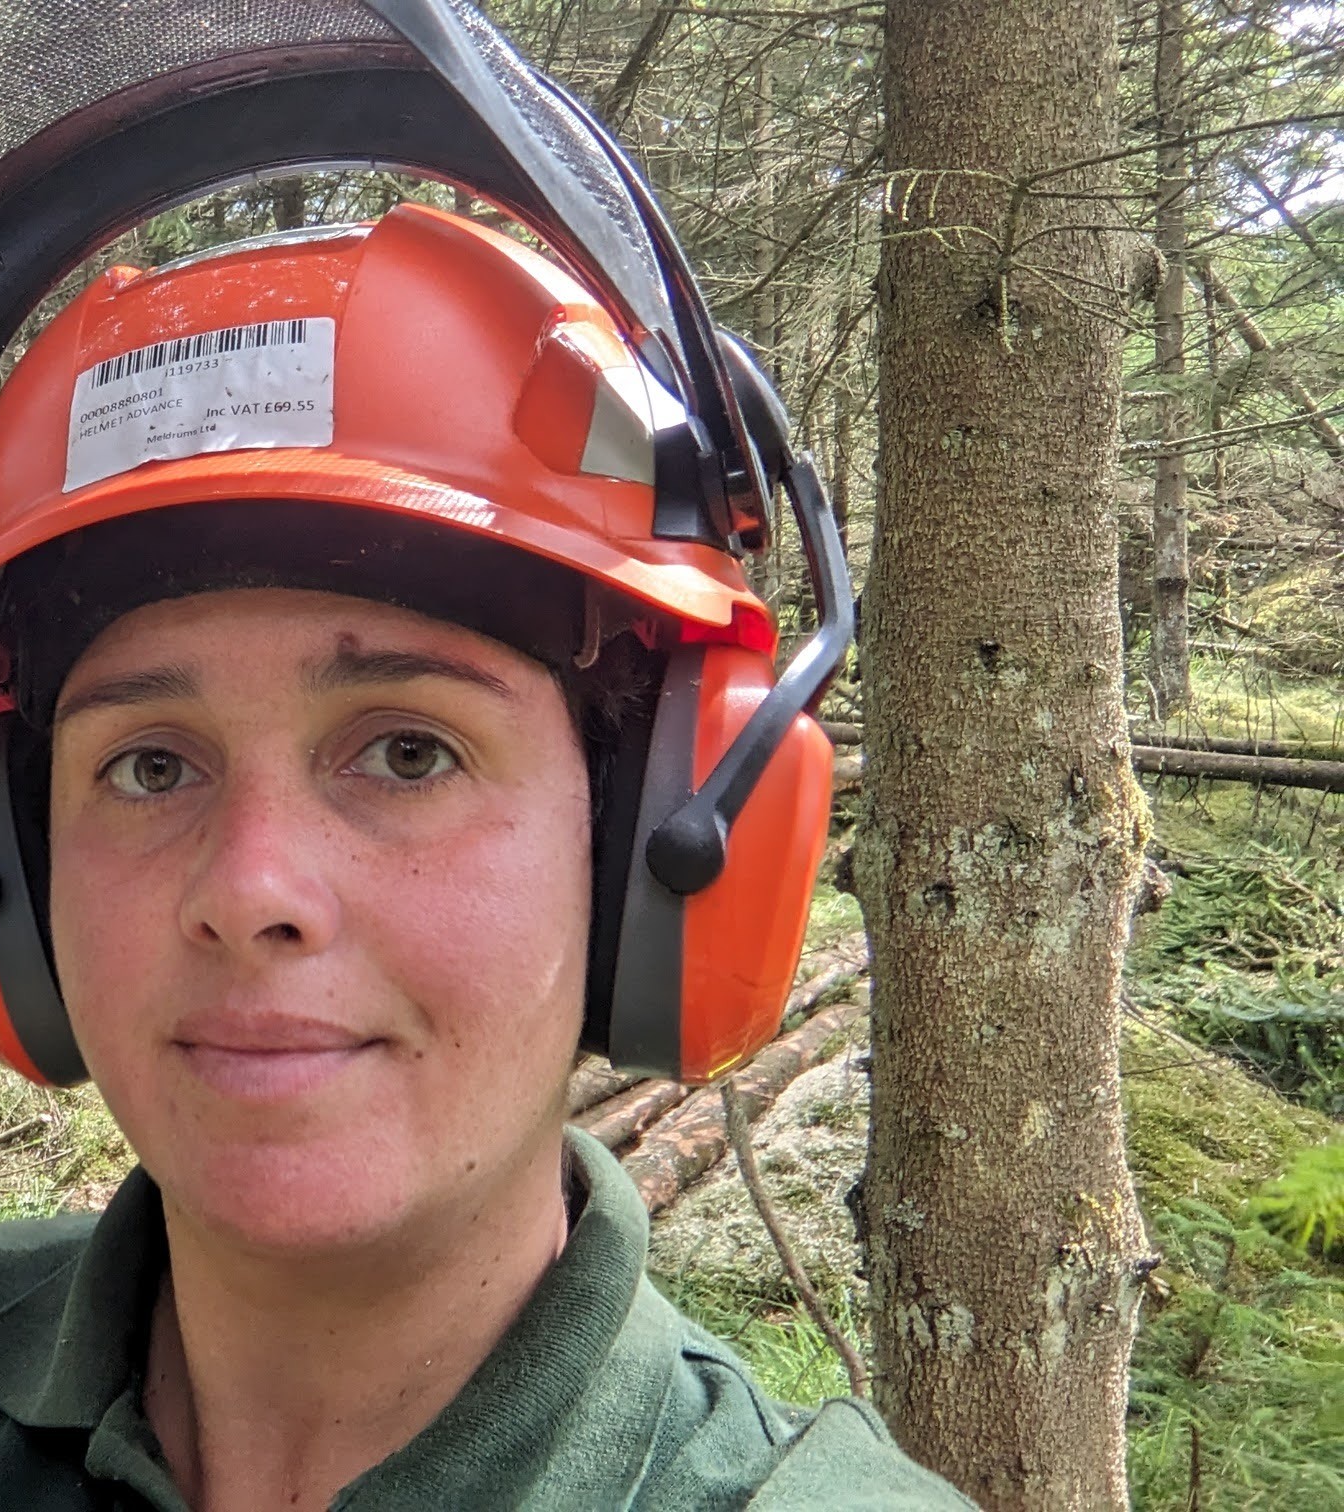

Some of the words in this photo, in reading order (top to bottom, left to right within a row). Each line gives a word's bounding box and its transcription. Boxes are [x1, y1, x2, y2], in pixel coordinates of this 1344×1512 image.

[79, 416, 123, 440] HELMET
[126, 398, 184, 422] ADVANCE
[206, 407, 226, 418] Inc
[231, 402, 260, 416] VAT
[264, 400, 315, 414] £69.55
[146, 429, 198, 444] Meldrums
[200, 423, 217, 434] Ltd
